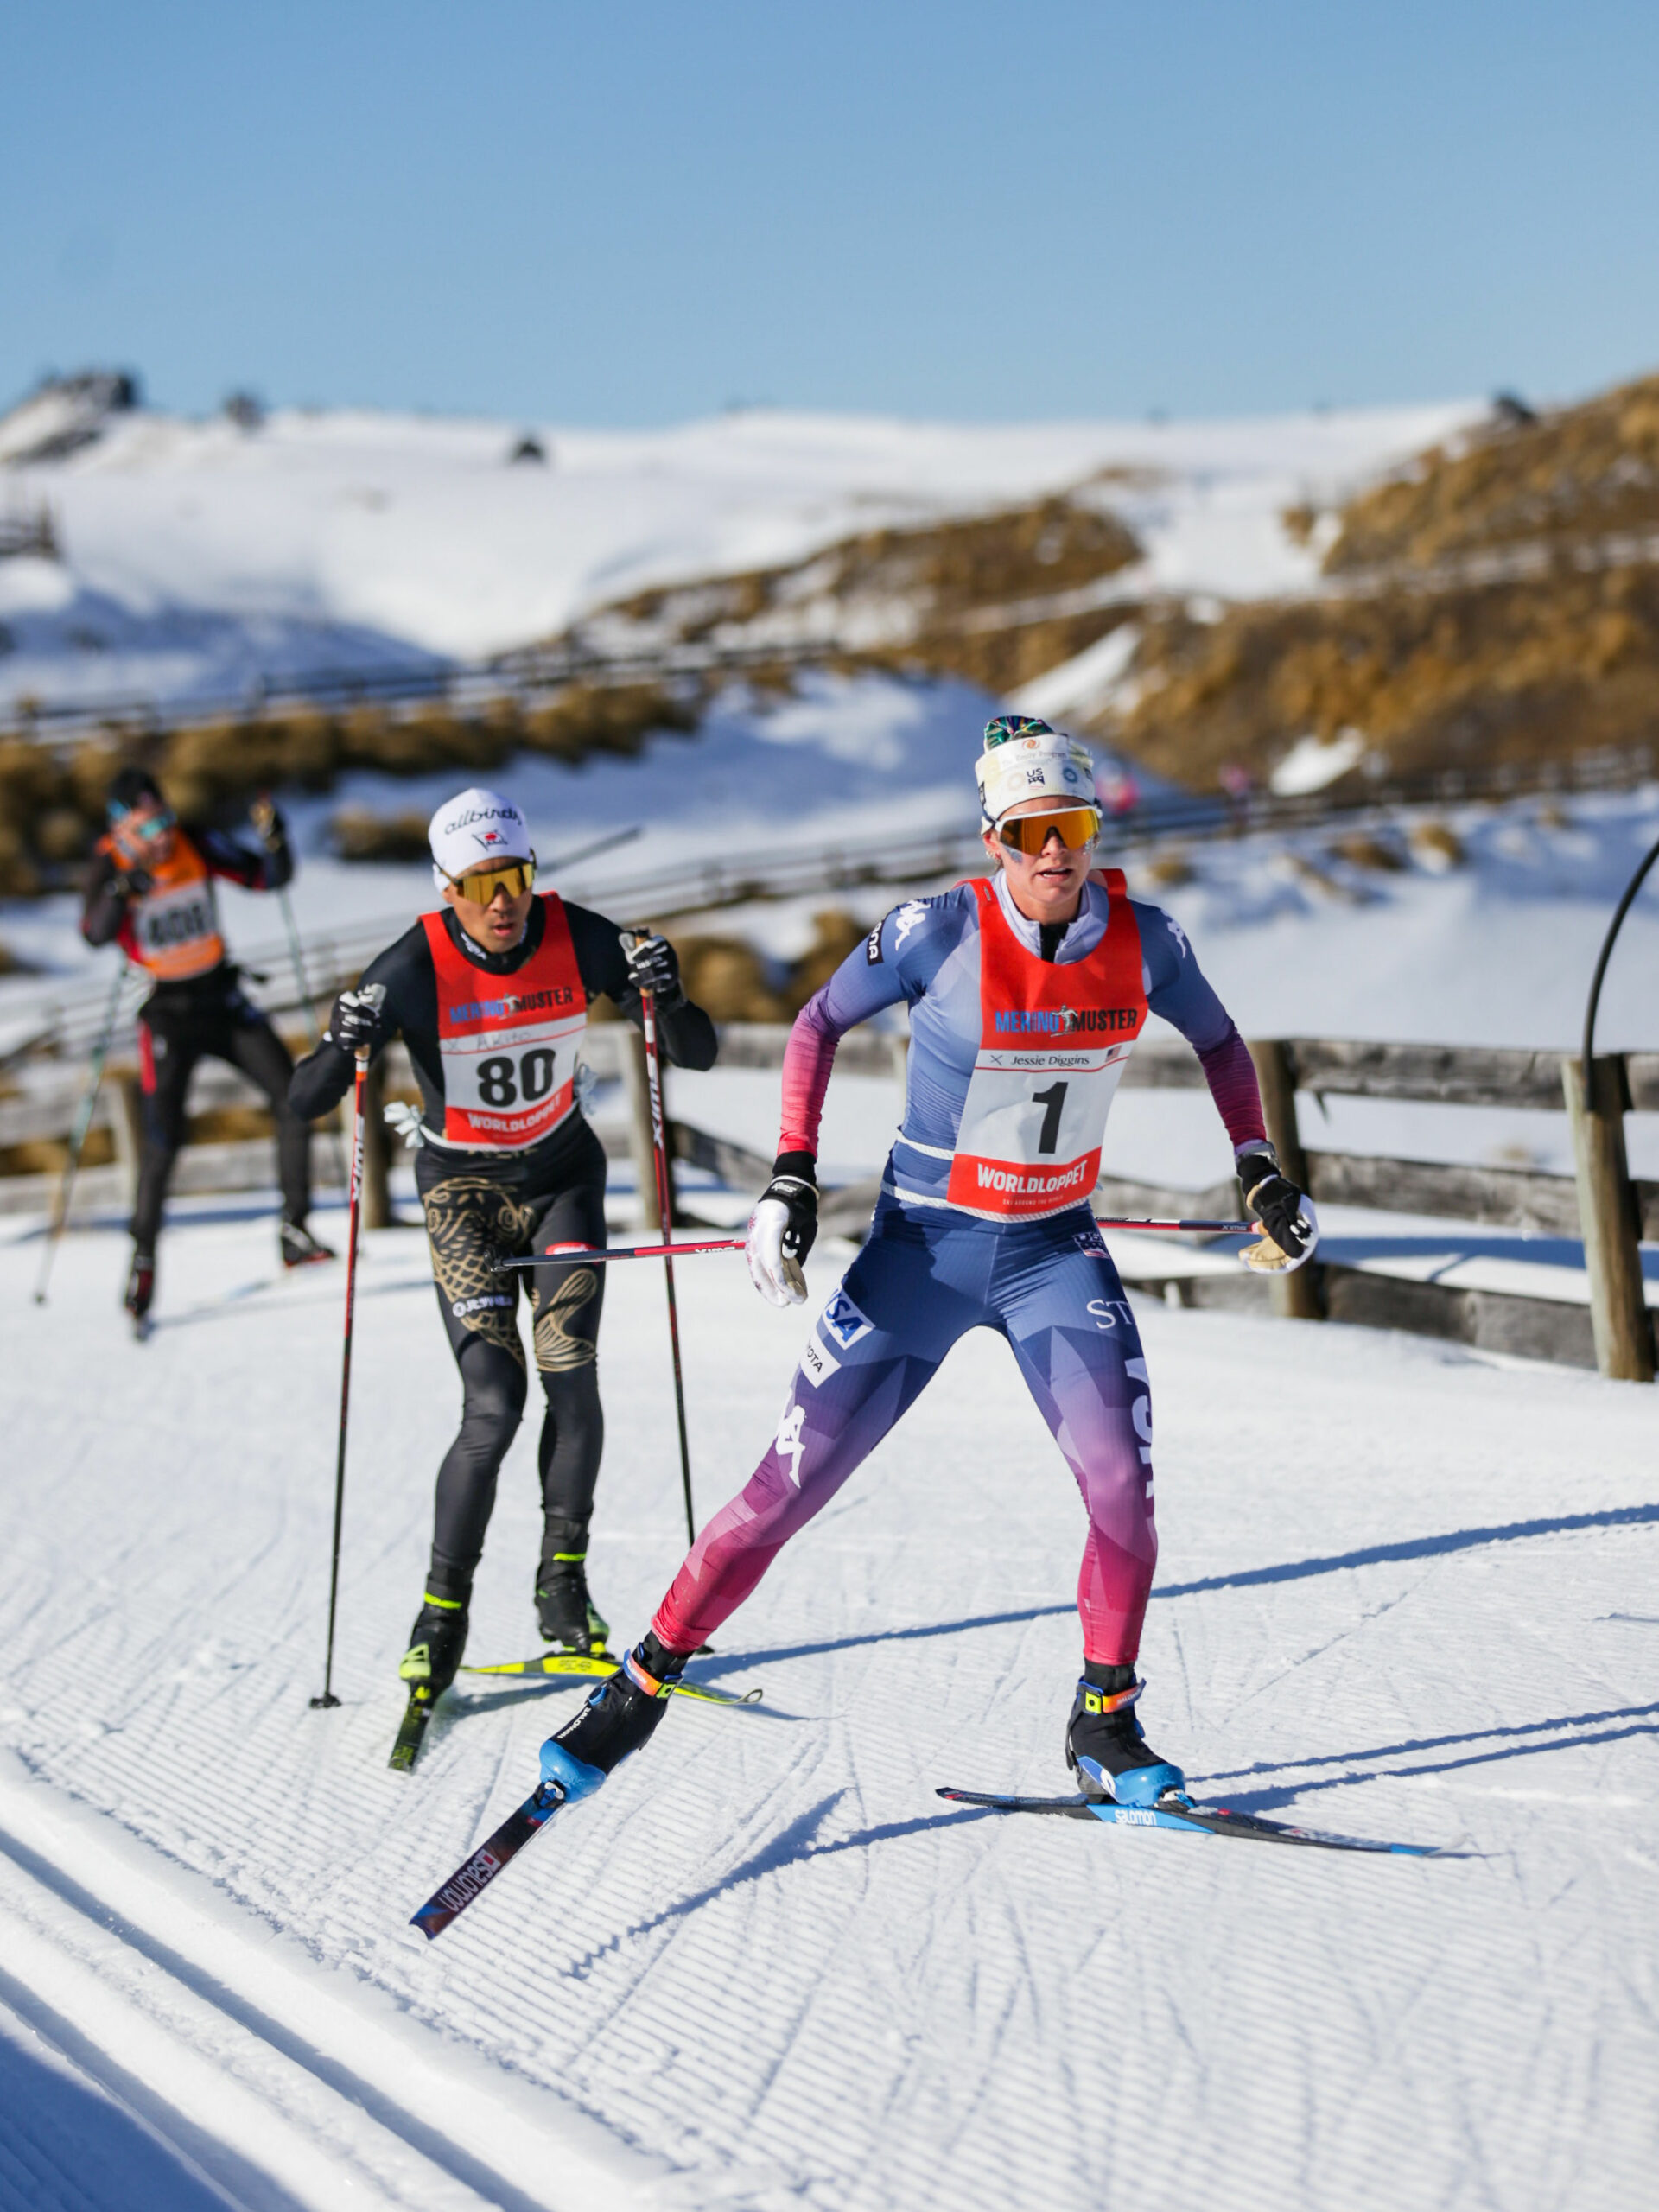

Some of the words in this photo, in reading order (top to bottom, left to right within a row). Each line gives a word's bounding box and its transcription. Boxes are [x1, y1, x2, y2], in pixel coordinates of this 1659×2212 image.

[444, 805, 523, 836] allbirds
[449, 999, 505, 1025] MERINO
[515, 986, 574, 1013] MUSTER
[995, 1010, 1059, 1033] MERINO
[1072, 1008, 1138, 1033] MUSTER
[477, 1047, 556, 1109] 80
[1011, 1054, 1046, 1066] Jessie
[1048, 1054, 1090, 1067] Diggins
[467, 1092, 561, 1133] WORLDLOPPET
[1032, 1081, 1069, 1154] 1
[977, 1159, 1088, 1194] WORLDLOPPET
